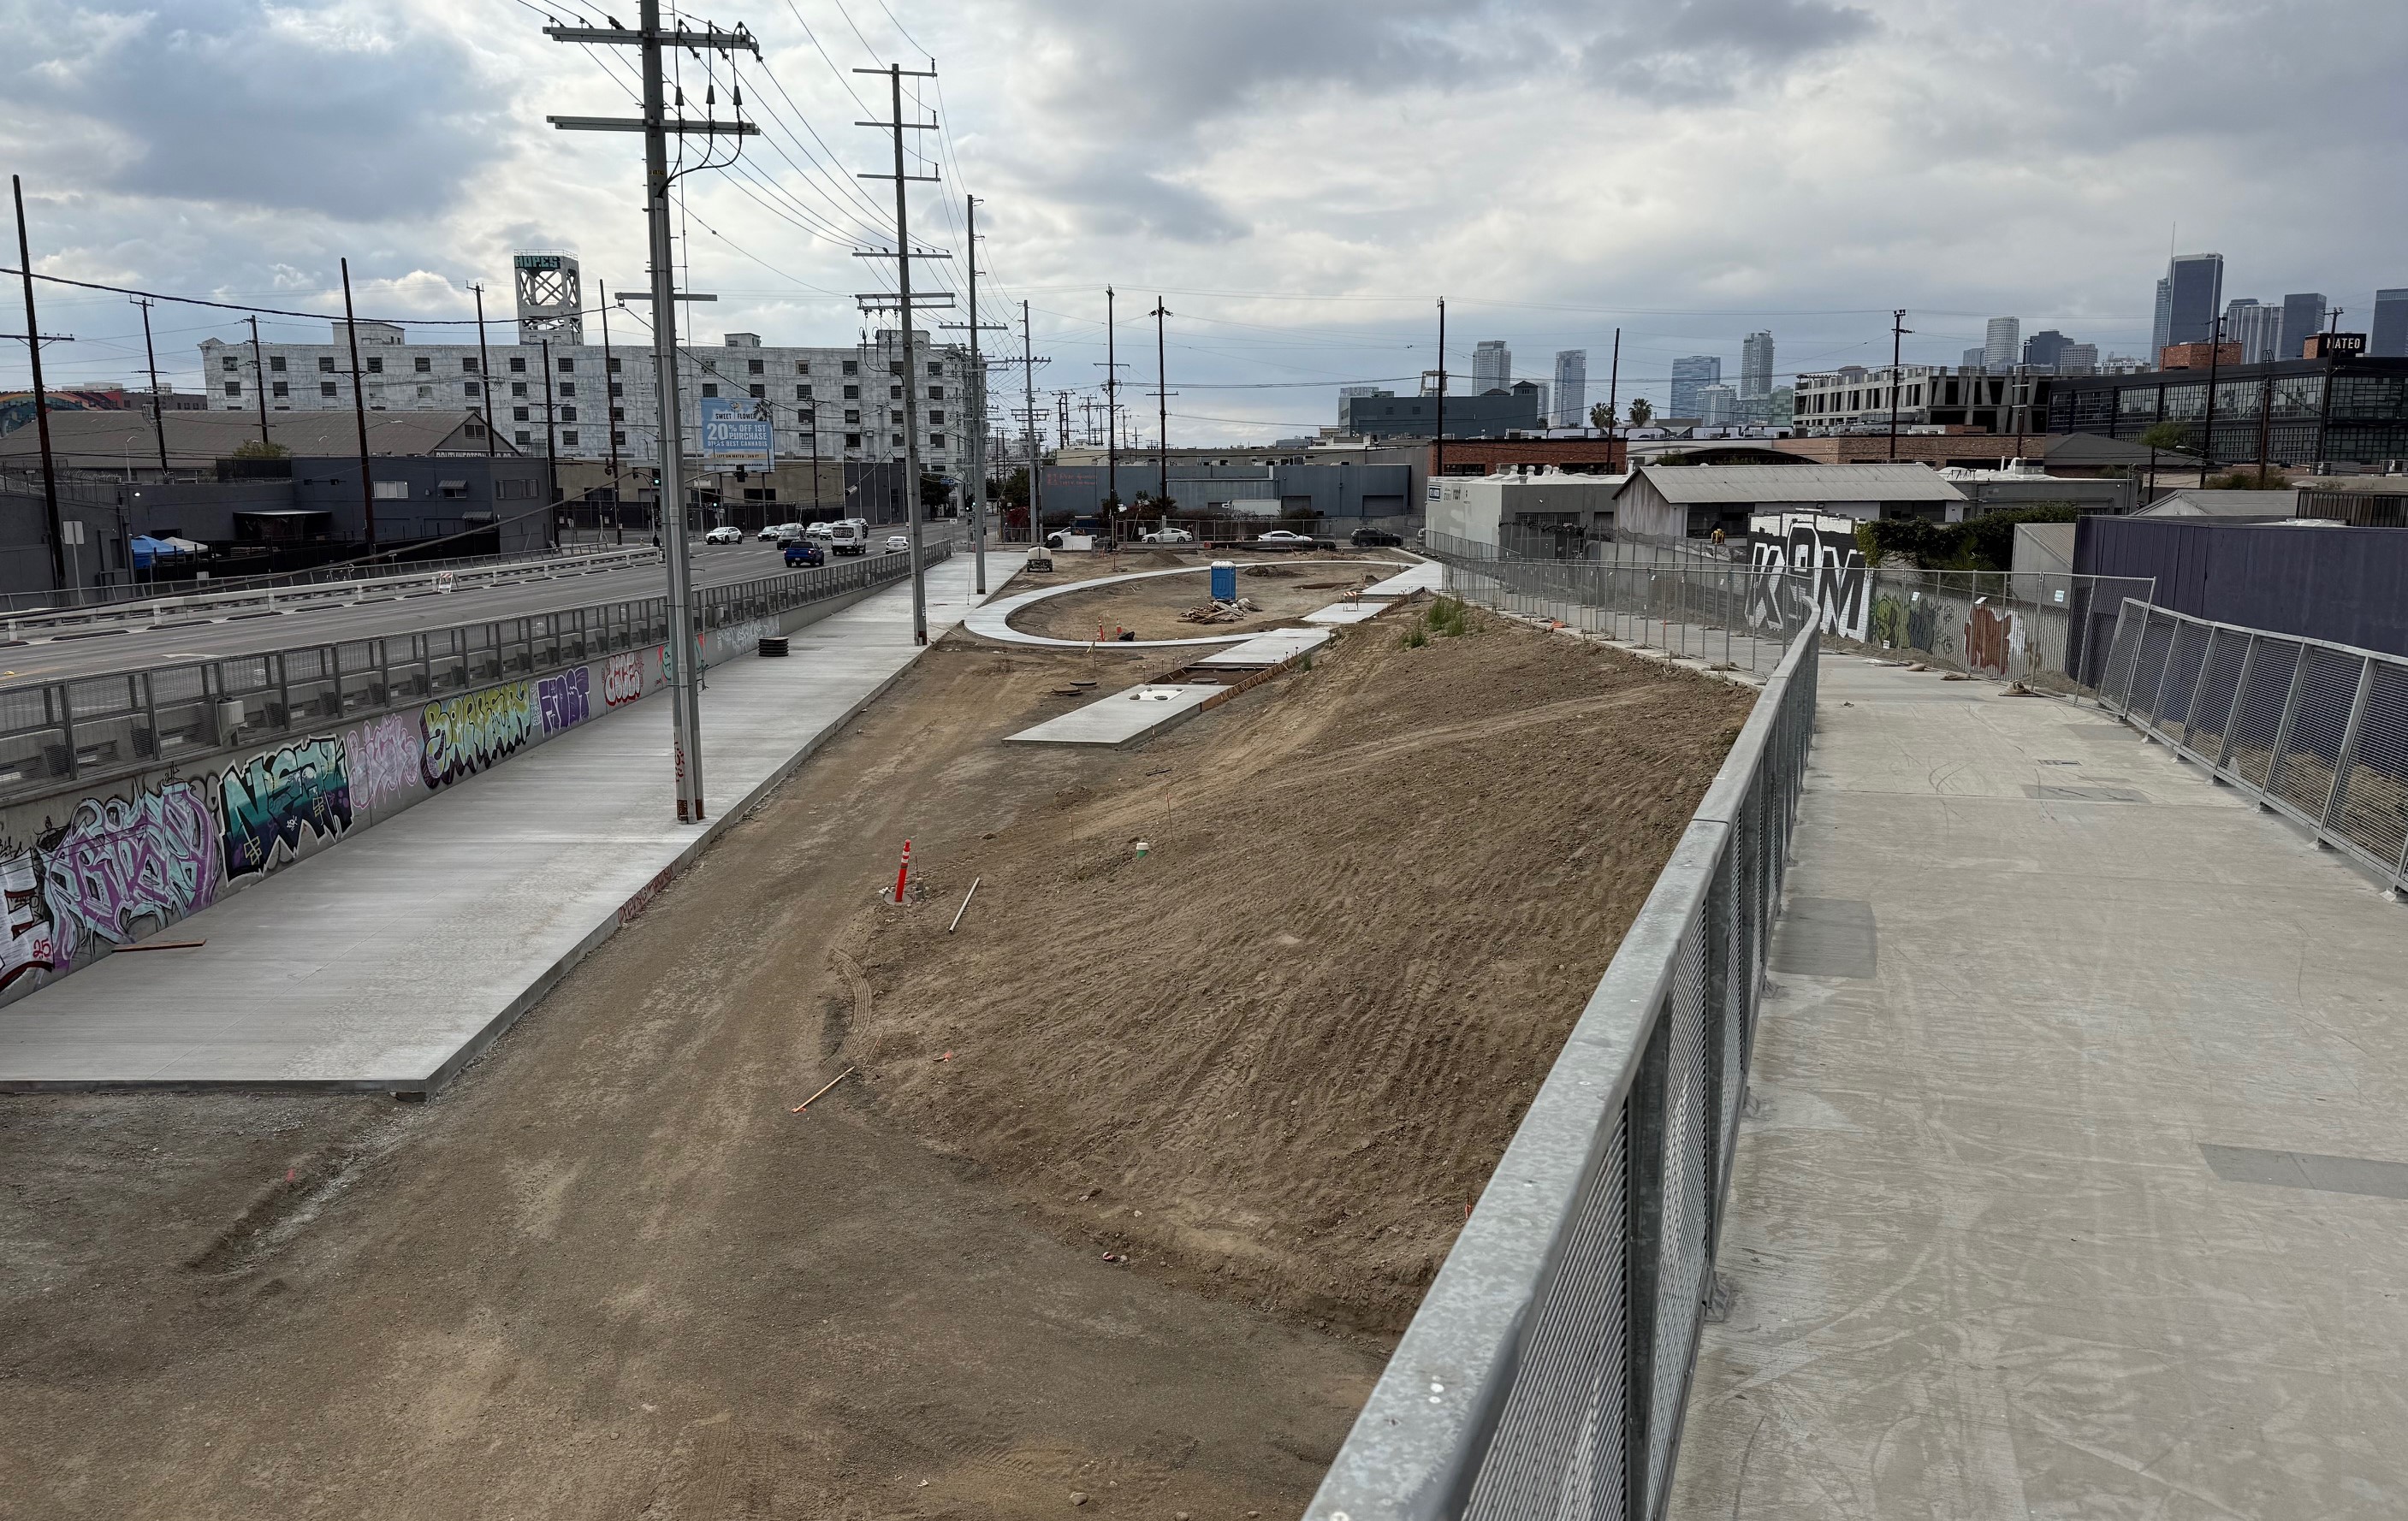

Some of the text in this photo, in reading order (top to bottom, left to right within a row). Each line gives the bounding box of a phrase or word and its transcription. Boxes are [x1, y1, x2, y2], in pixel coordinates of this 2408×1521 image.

[514, 256, 559, 268] HOPES
[729, 432, 768, 441] PURCHASE
[33, 938, 51, 958] 25
